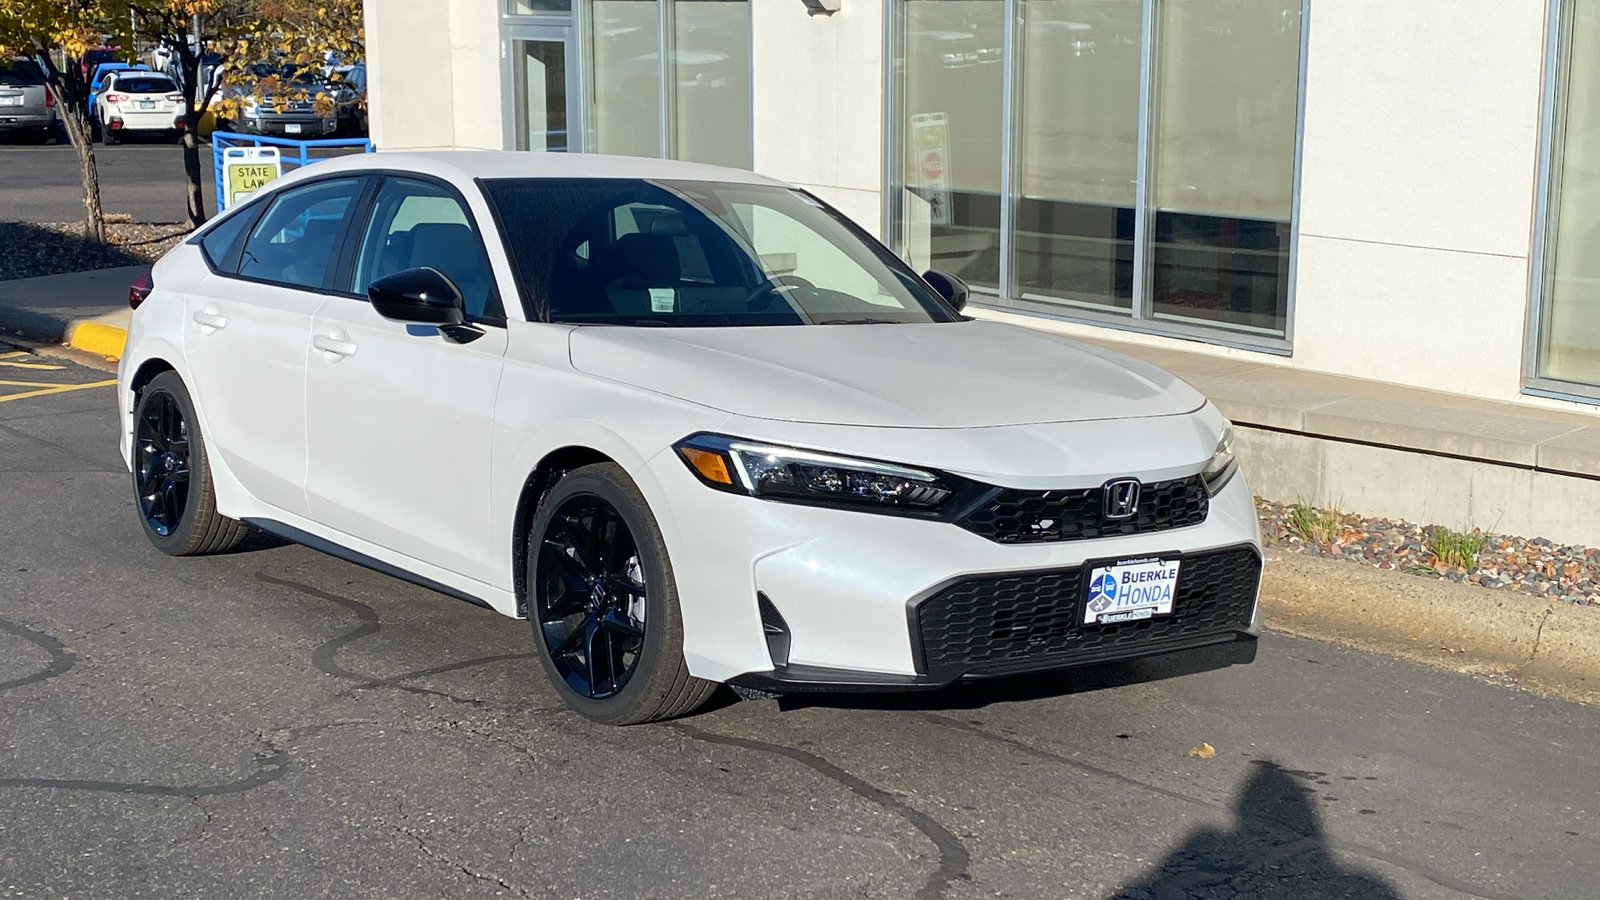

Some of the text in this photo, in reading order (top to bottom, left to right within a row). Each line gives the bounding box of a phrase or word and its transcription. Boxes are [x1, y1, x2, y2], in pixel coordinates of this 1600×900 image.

[238, 167, 269, 177] STATE
[244, 179, 264, 188] LAW
[1121, 568, 1176, 584] BUERKLE
[1117, 584, 1171, 606] HONDA
